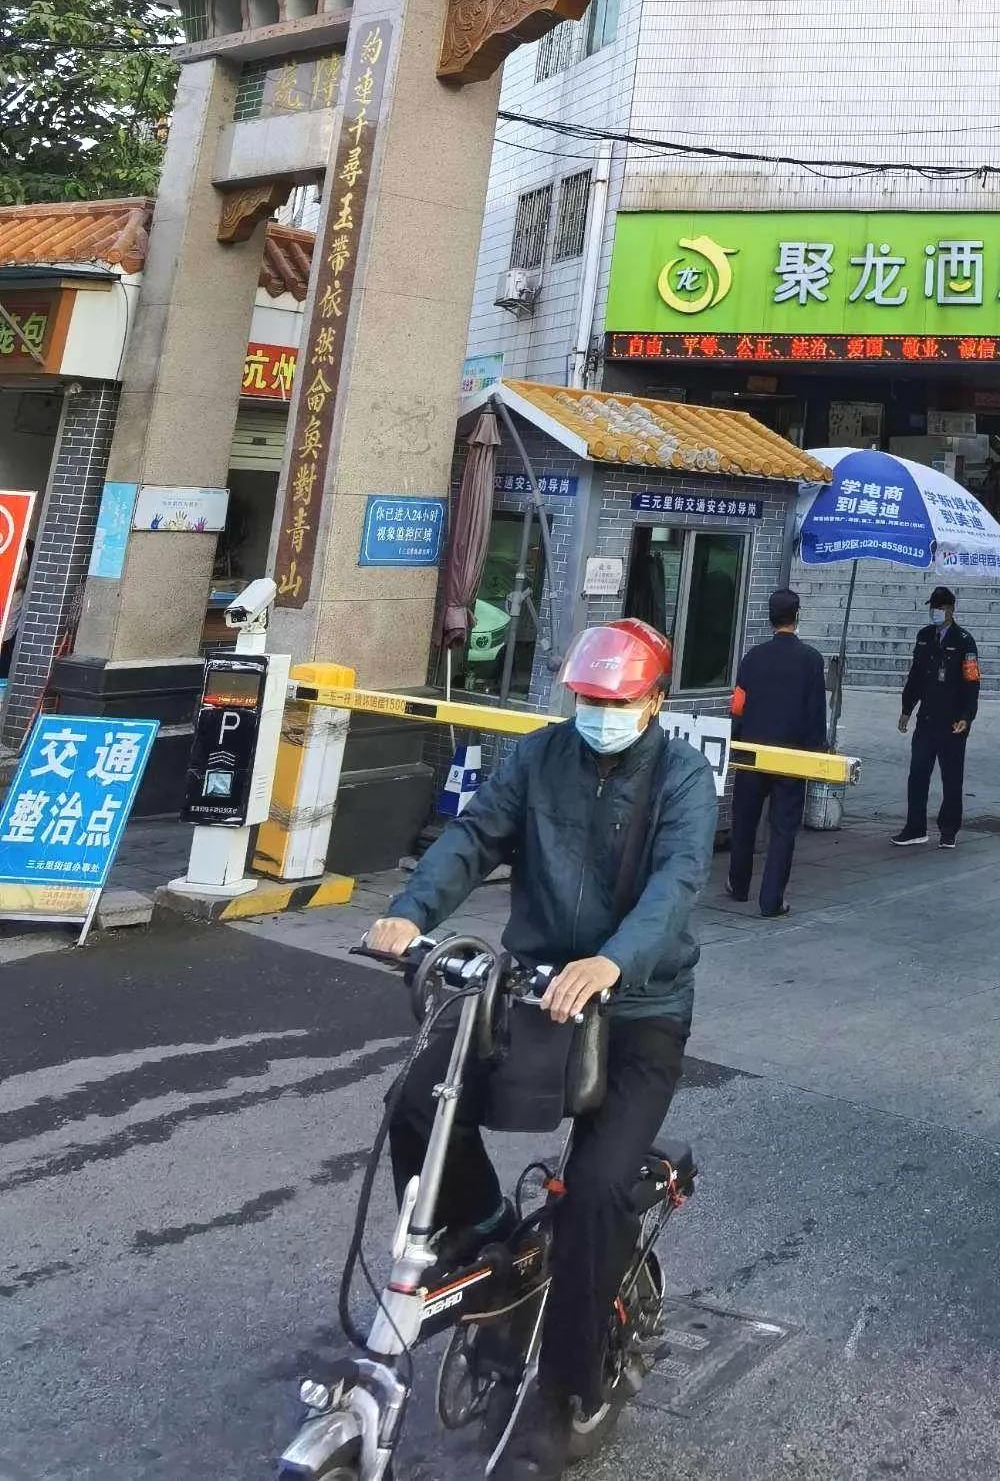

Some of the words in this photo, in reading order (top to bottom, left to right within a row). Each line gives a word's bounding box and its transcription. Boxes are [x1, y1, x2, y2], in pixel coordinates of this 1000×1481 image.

[840, 479, 904, 502] 学电商
[639, 494, 757, 517] 三元里街交通安全劝导岗
[835, 495, 900, 518] 到美迪
[217, 711, 241, 745] P
[30, 727, 144, 786] 交通
[1, 789, 123, 848] 整治点
